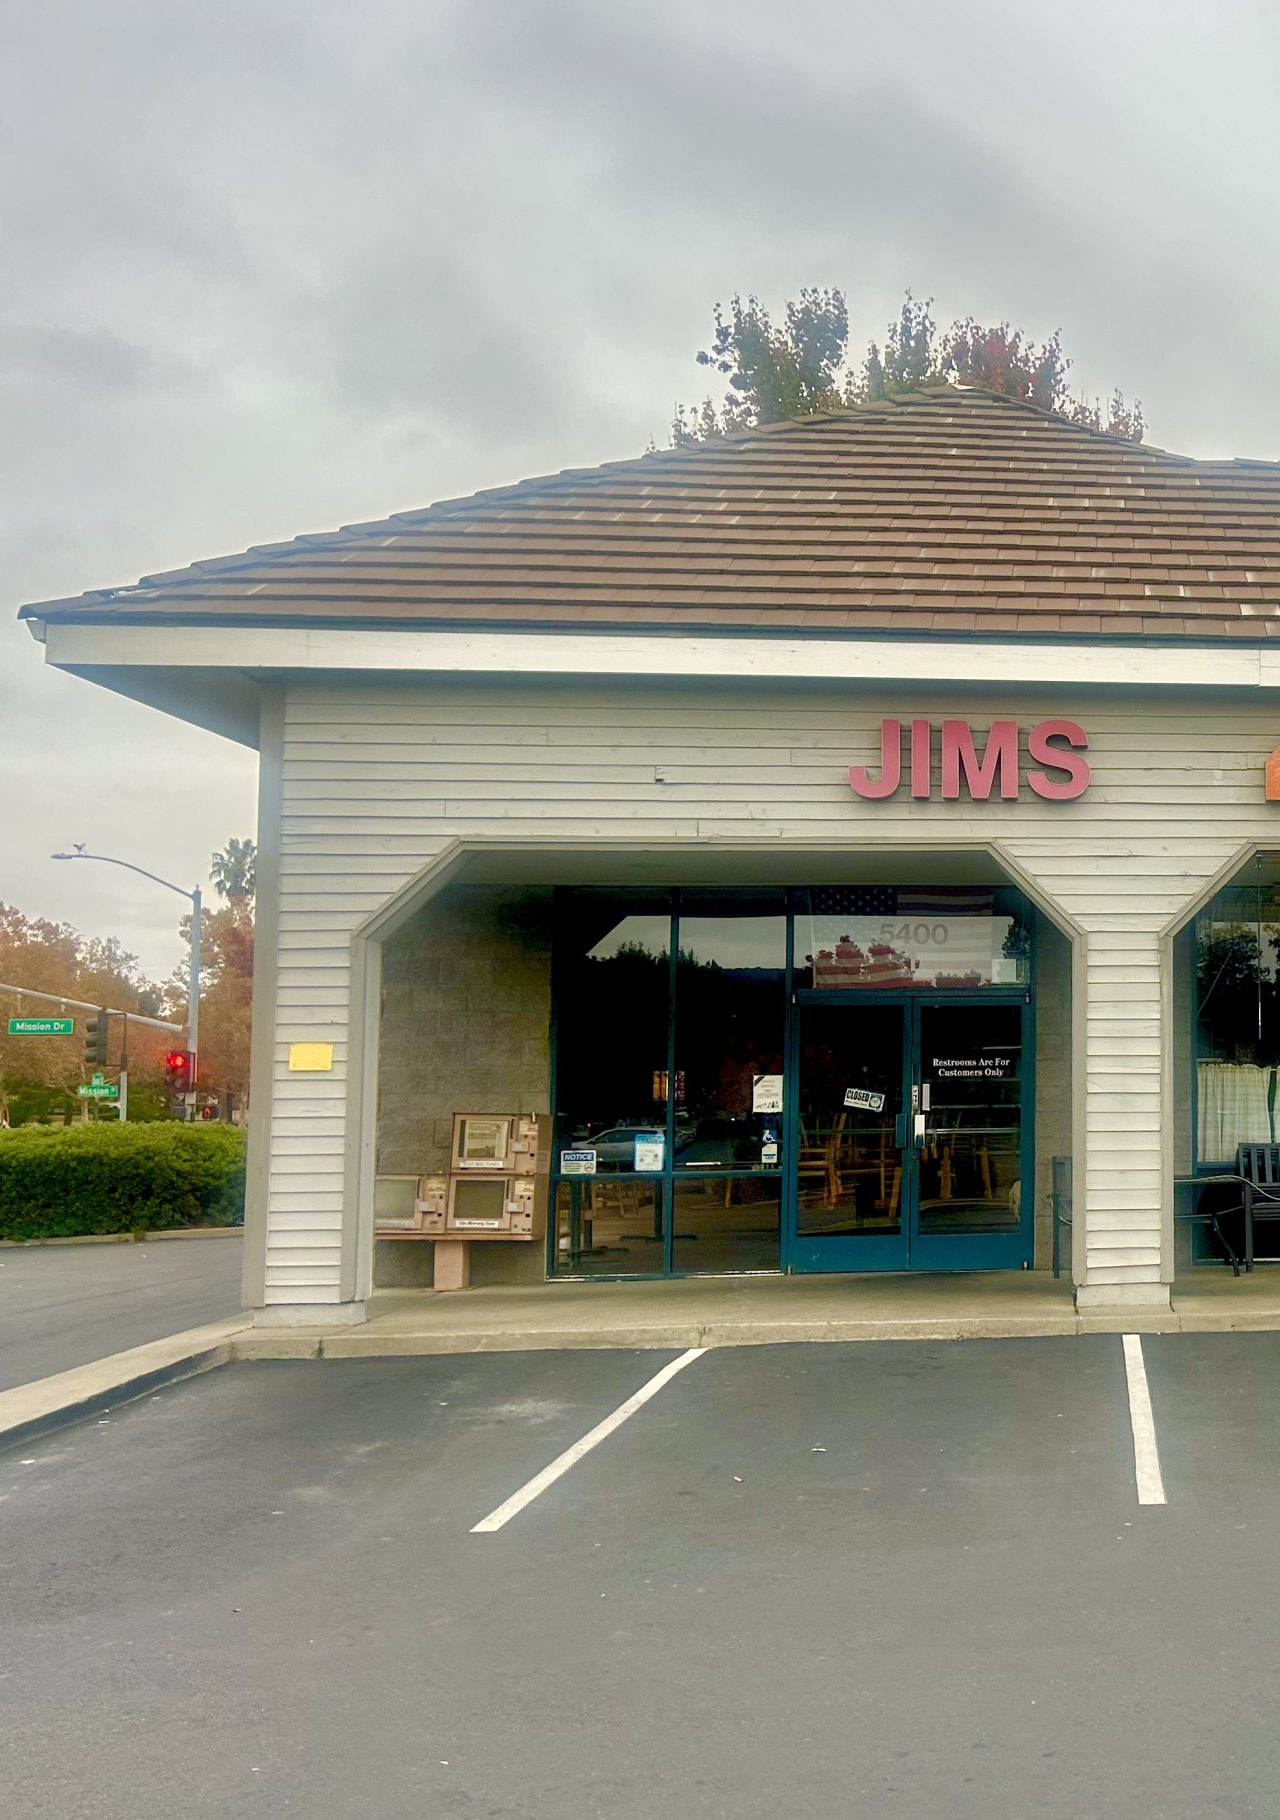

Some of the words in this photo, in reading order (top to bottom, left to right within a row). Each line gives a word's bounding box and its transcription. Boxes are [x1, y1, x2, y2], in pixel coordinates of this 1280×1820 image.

[848, 718, 1090, 800] JIMS
[879, 923, 949, 945] 5400
[15, 1022, 51, 1031] Mission
[53, 1022, 65, 1030] Dr
[932, 1058, 977, 1067] Restrooms
[978, 1058, 994, 1066] Are
[994, 1057, 1010, 1066] For
[938, 1068, 983, 1077] Customers
[984, 1068, 1004, 1077] Only
[80, 1086, 110, 1096] Mission
[846, 1089, 870, 1102] CLOSED
[564, 1153, 593, 1161] NOTICE
